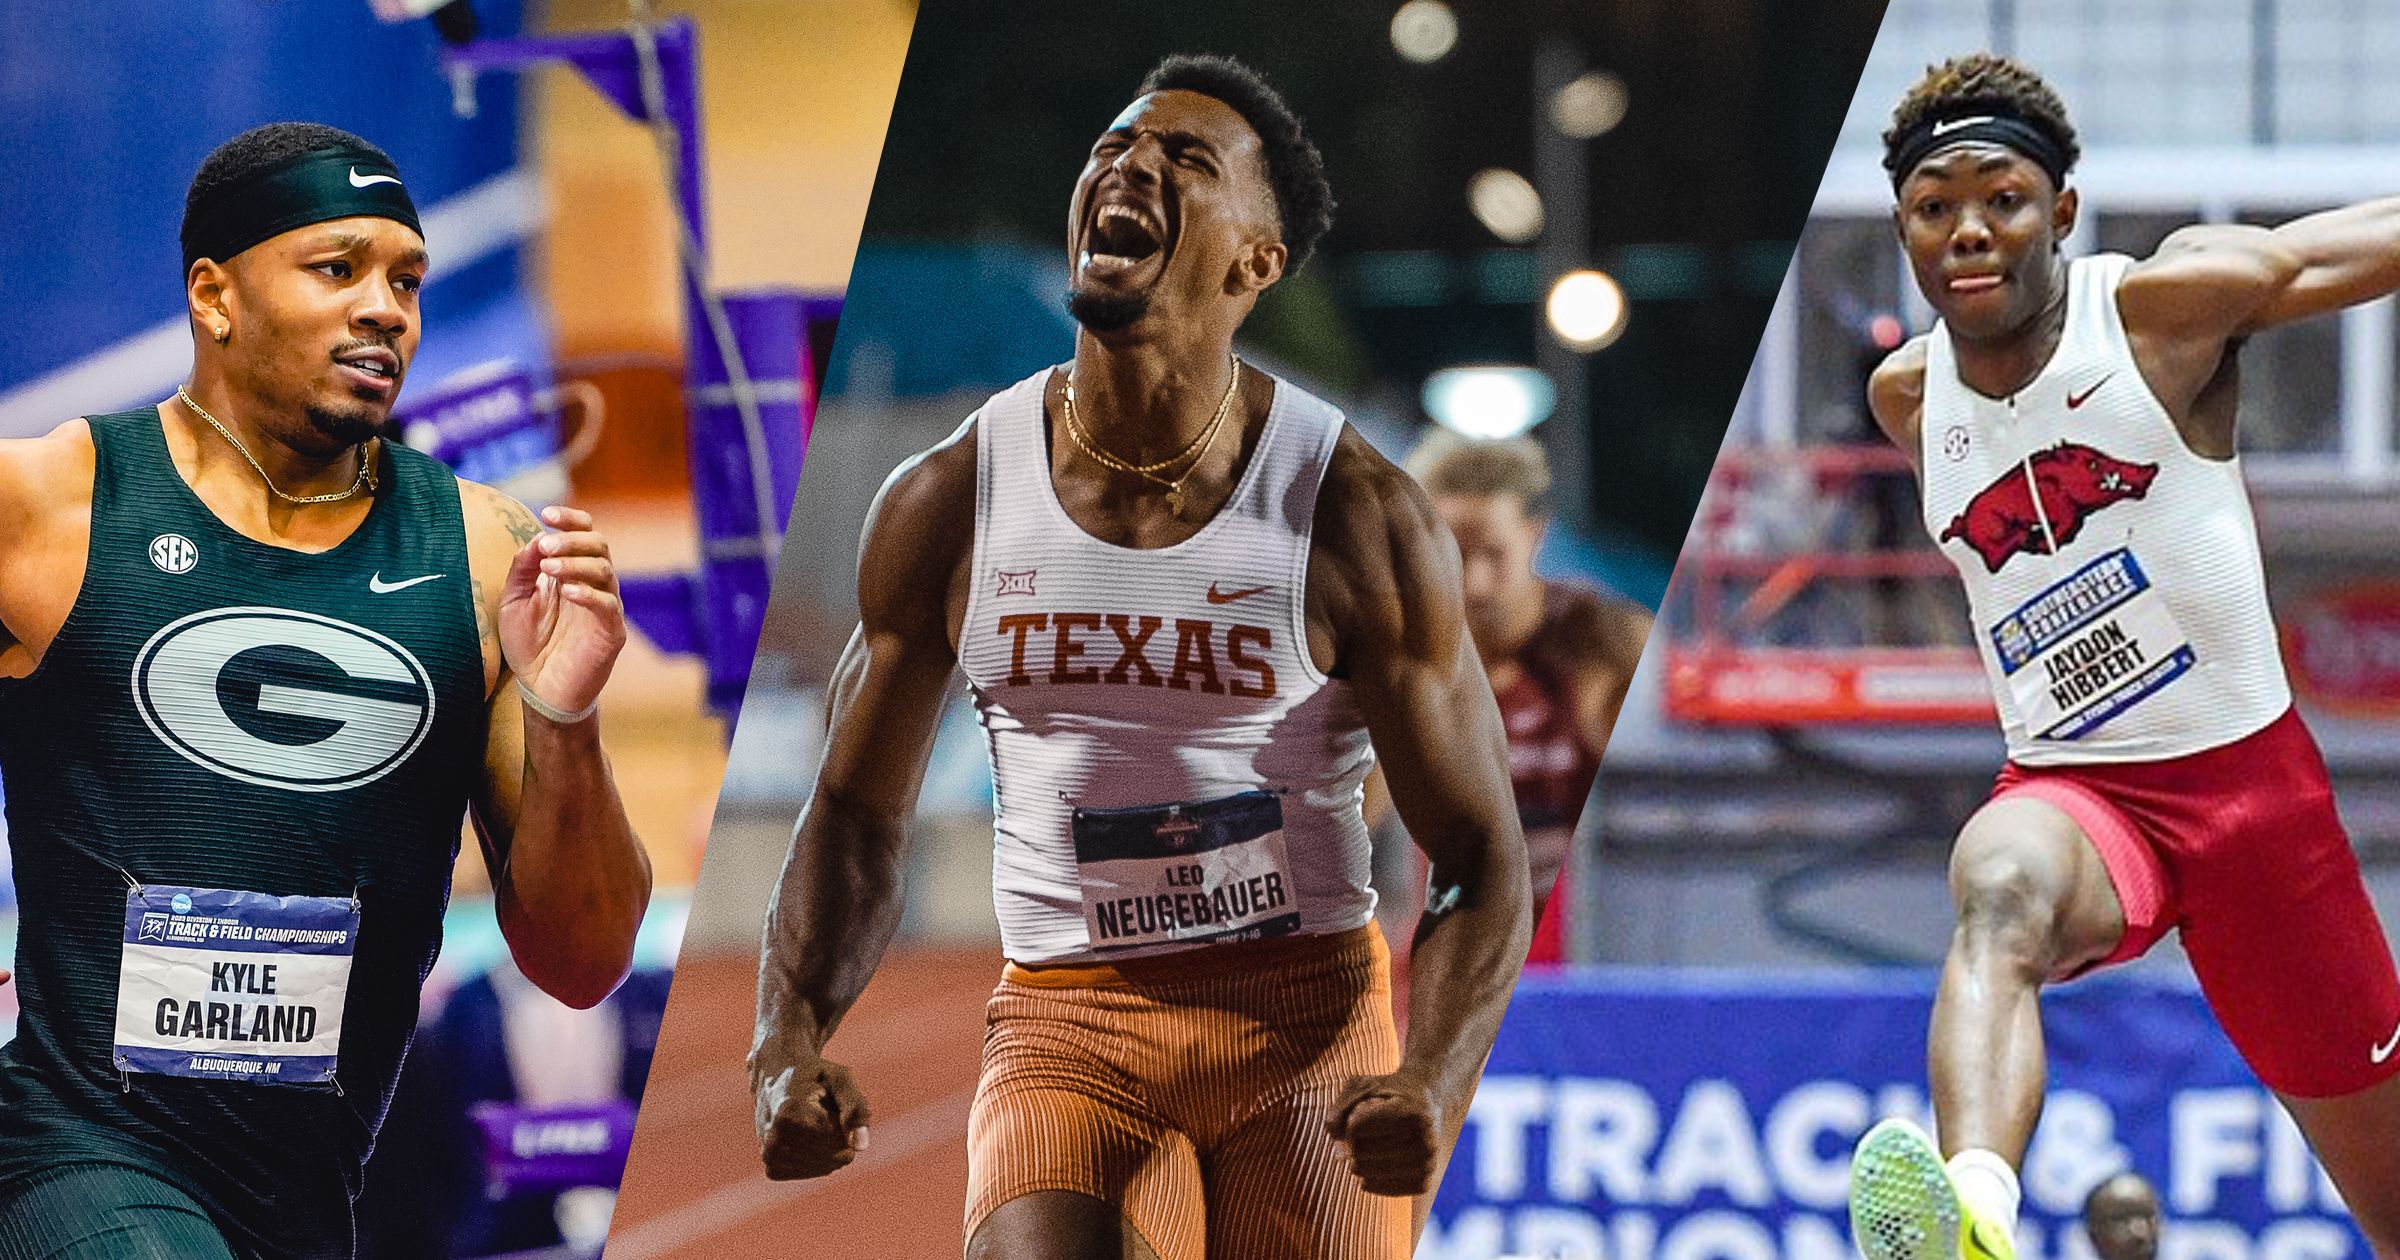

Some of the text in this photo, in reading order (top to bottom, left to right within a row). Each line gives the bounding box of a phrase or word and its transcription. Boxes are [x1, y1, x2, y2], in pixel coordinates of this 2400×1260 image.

[152, 535, 196, 571] SEC
[997, 612, 1277, 699] TEXAS
[2044, 619, 2126, 684] JAYDON
[2050, 639, 2146, 711] HIBBERT
[1166, 864, 1204, 887] LEO
[186, 916, 212, 924] DIVISION
[1095, 871, 1288, 940] NEUGEBAUER
[169, 922, 348, 945] TRACK & FIELD CHAMPIONSHIPS
[211, 961, 278, 995] KYLE
[155, 997, 317, 1043] GARLAND
[189, 1057, 282, 1074] ALBUQUERQUE, NM
[1470, 1074, 1936, 1209] TRAC
